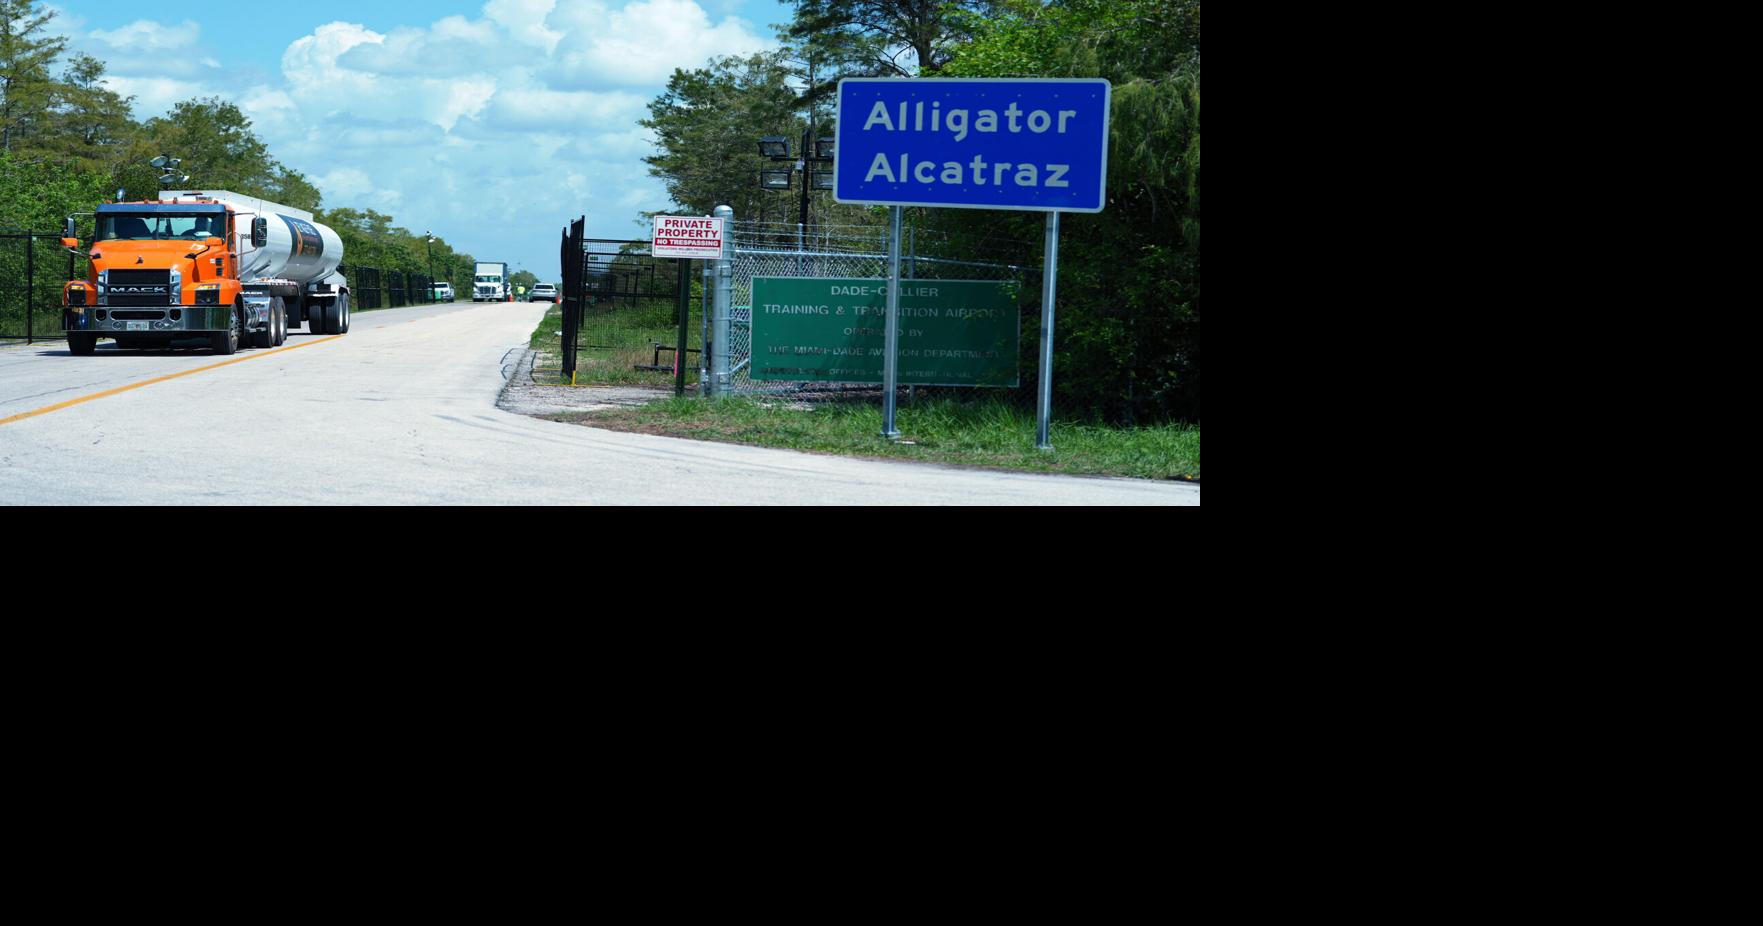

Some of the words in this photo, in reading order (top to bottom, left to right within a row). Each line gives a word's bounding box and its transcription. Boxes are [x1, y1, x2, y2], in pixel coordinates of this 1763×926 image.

[863, 100, 1077, 142] Alligator
[864, 152, 1070, 188] Alcatraz
[665, 220, 713, 229] PRIVATE
[657, 228, 718, 238] PROPERTY
[830, 285, 939, 297] DADE-CLLIER
[762, 303, 829, 315] TRAINING
[835, 305, 845, 316] &
[852, 305, 939, 318] TRANITION
[909, 328, 924, 337] BY
